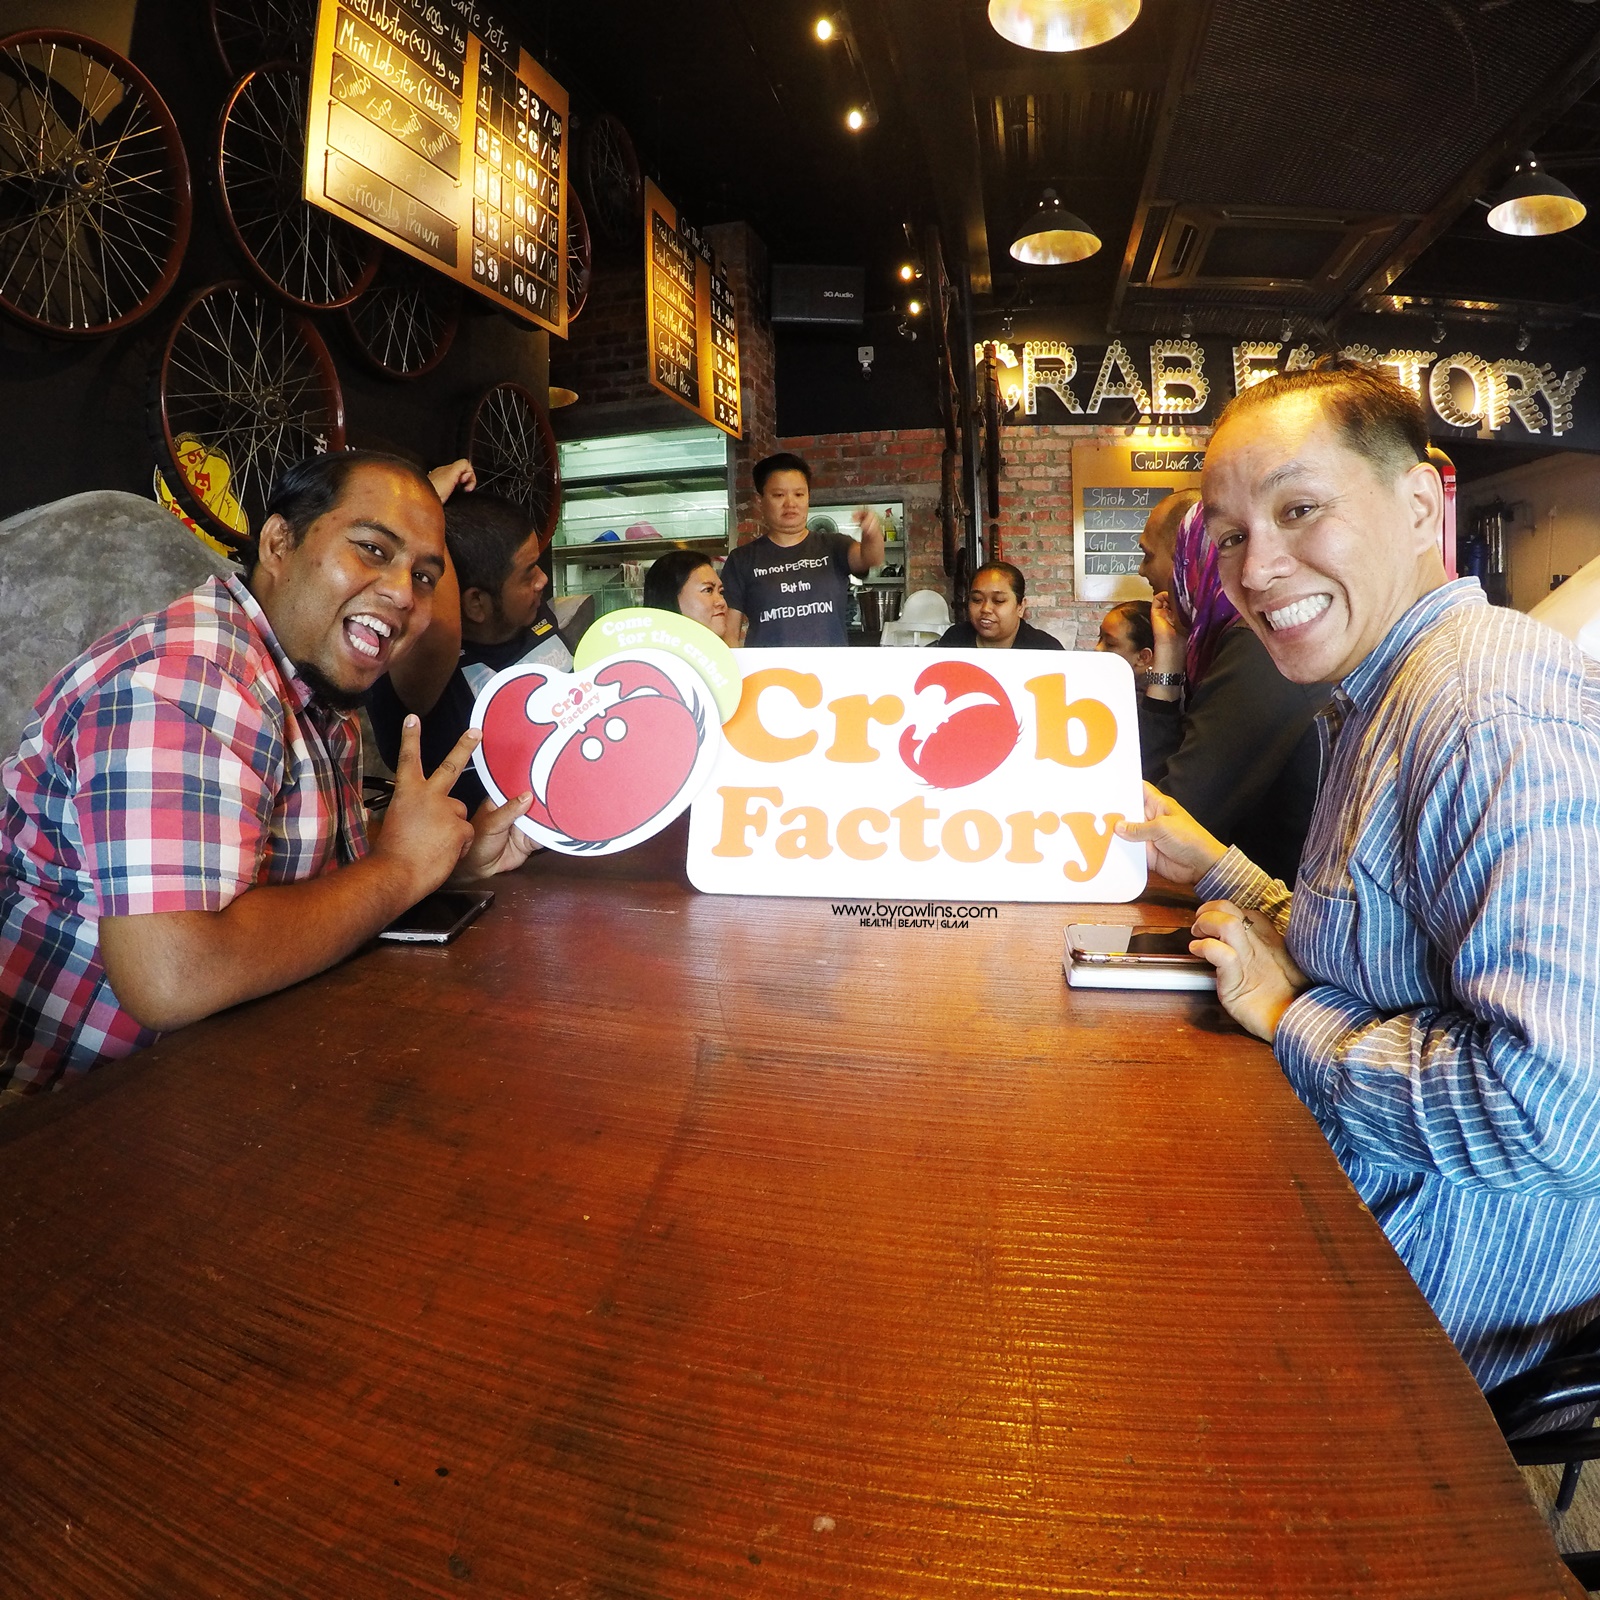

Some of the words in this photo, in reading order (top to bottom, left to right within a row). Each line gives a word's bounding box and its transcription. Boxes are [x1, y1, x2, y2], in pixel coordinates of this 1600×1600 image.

[485, 16, 509, 53] Sets
[339, 19, 373, 62] Mini
[373, 40, 416, 95] Lobster
[449, 70, 460, 89] up
[334, 65, 371, 98] Jumbo
[420, 132, 451, 159] Prawn
[406, 201, 440, 249] Prawn
[834, 291, 854, 299] Audio
[975, 339, 1211, 415] CRAB
[1134, 451, 1163, 470] Crab
[1165, 451, 1189, 470] Lover
[1193, 453, 1205, 470] Se
[1092, 488, 1125, 506] Shiok
[1132, 489, 1149, 506] Set
[1092, 511, 1126, 529] Party
[1130, 534, 1142, 551] Se
[754, 568, 767, 577] I'm
[769, 565, 785, 574] not
[785, 556, 829, 572] PERFECT
[1087, 556, 1107, 573] The
[1109, 555, 1126, 574] Big
[780, 582, 797, 593] But
[798, 580, 811, 592] I'm
[760, 606, 795, 623] LIMITED
[797, 600, 833, 617] EDITION
[602, 616, 653, 636] Come
[617, 631, 646, 647] for
[651, 630, 681, 647] the
[683, 643, 728, 689] crabs!
[559, 692, 600, 729] Factory
[711, 786, 1126, 882] Factory
